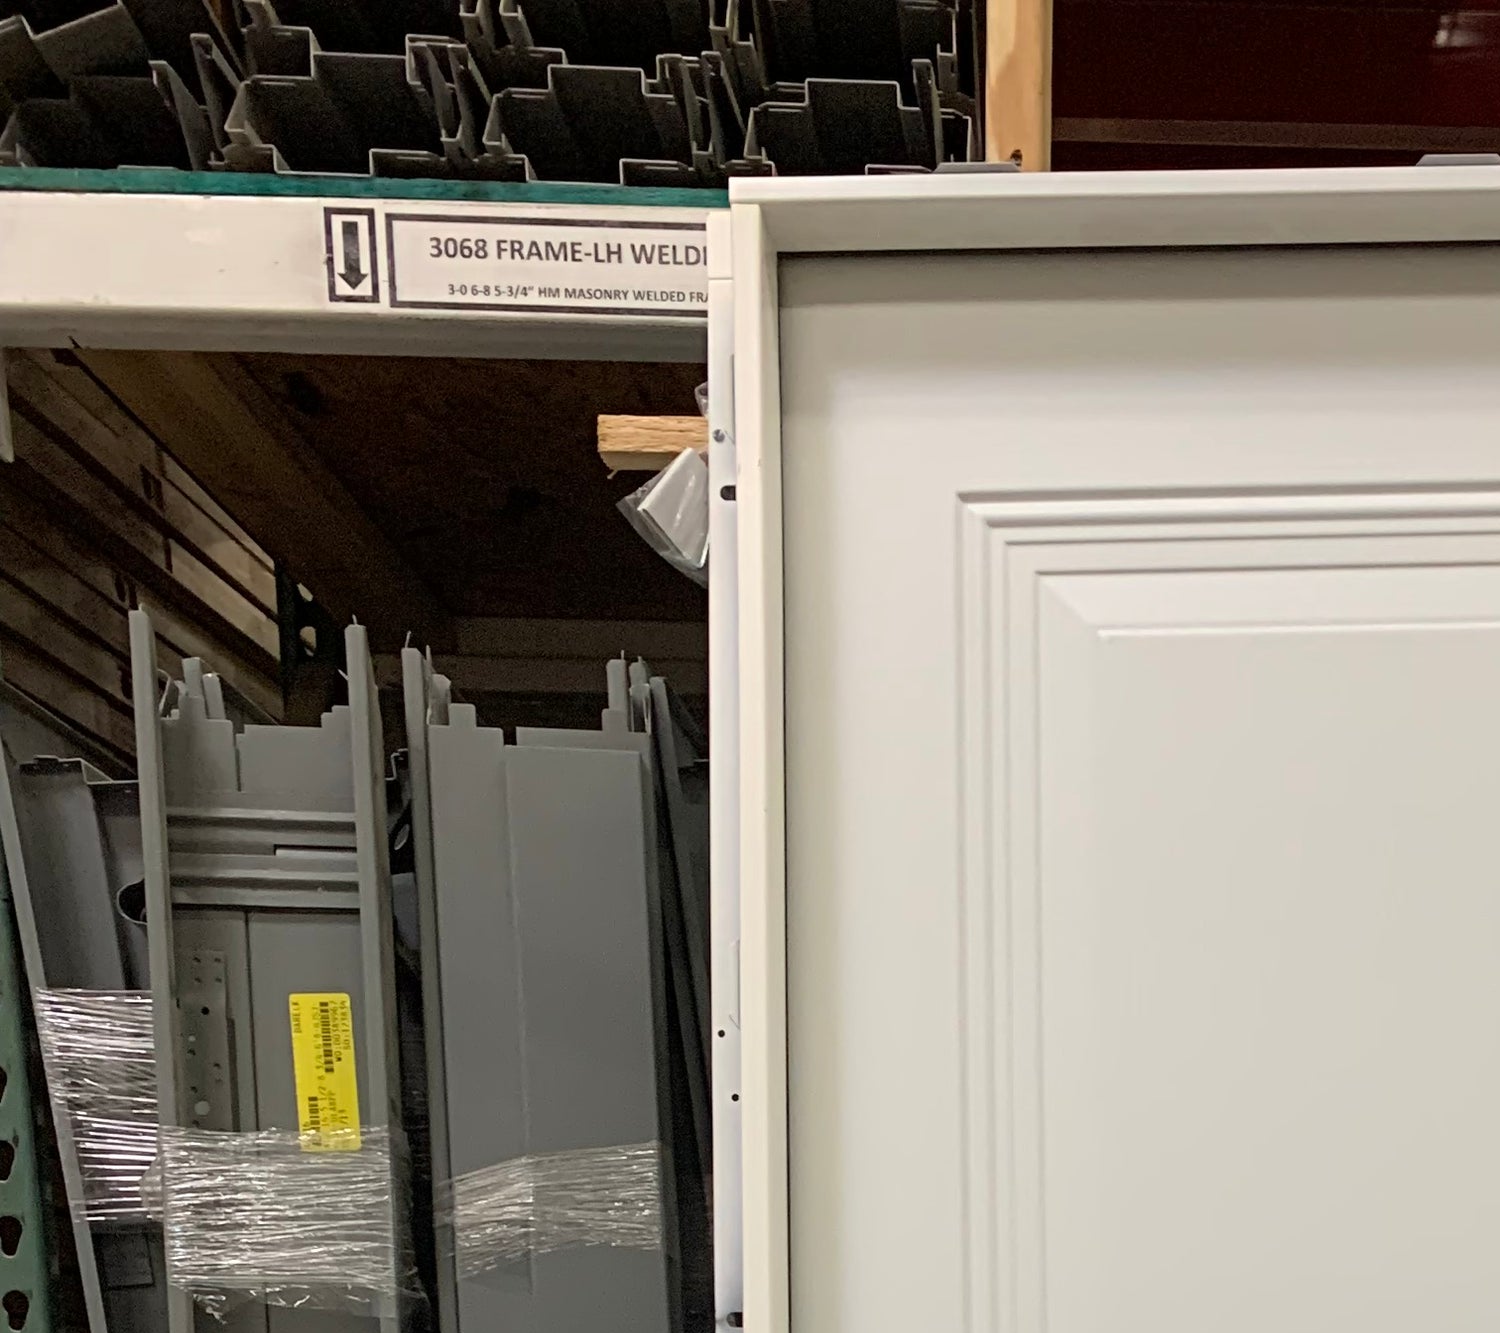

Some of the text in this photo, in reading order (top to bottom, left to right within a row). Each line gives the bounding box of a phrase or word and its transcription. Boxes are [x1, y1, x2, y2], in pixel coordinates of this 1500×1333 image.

[429, 236, 707, 266] 3068 FRAME-LH WELD
[448, 284, 468, 296] 3-0
[471, 285, 491, 296] 6-8
[538, 286, 560, 298] HM
[564, 288, 629, 300] MASONRY
[632, 290, 686, 302] WELDED
